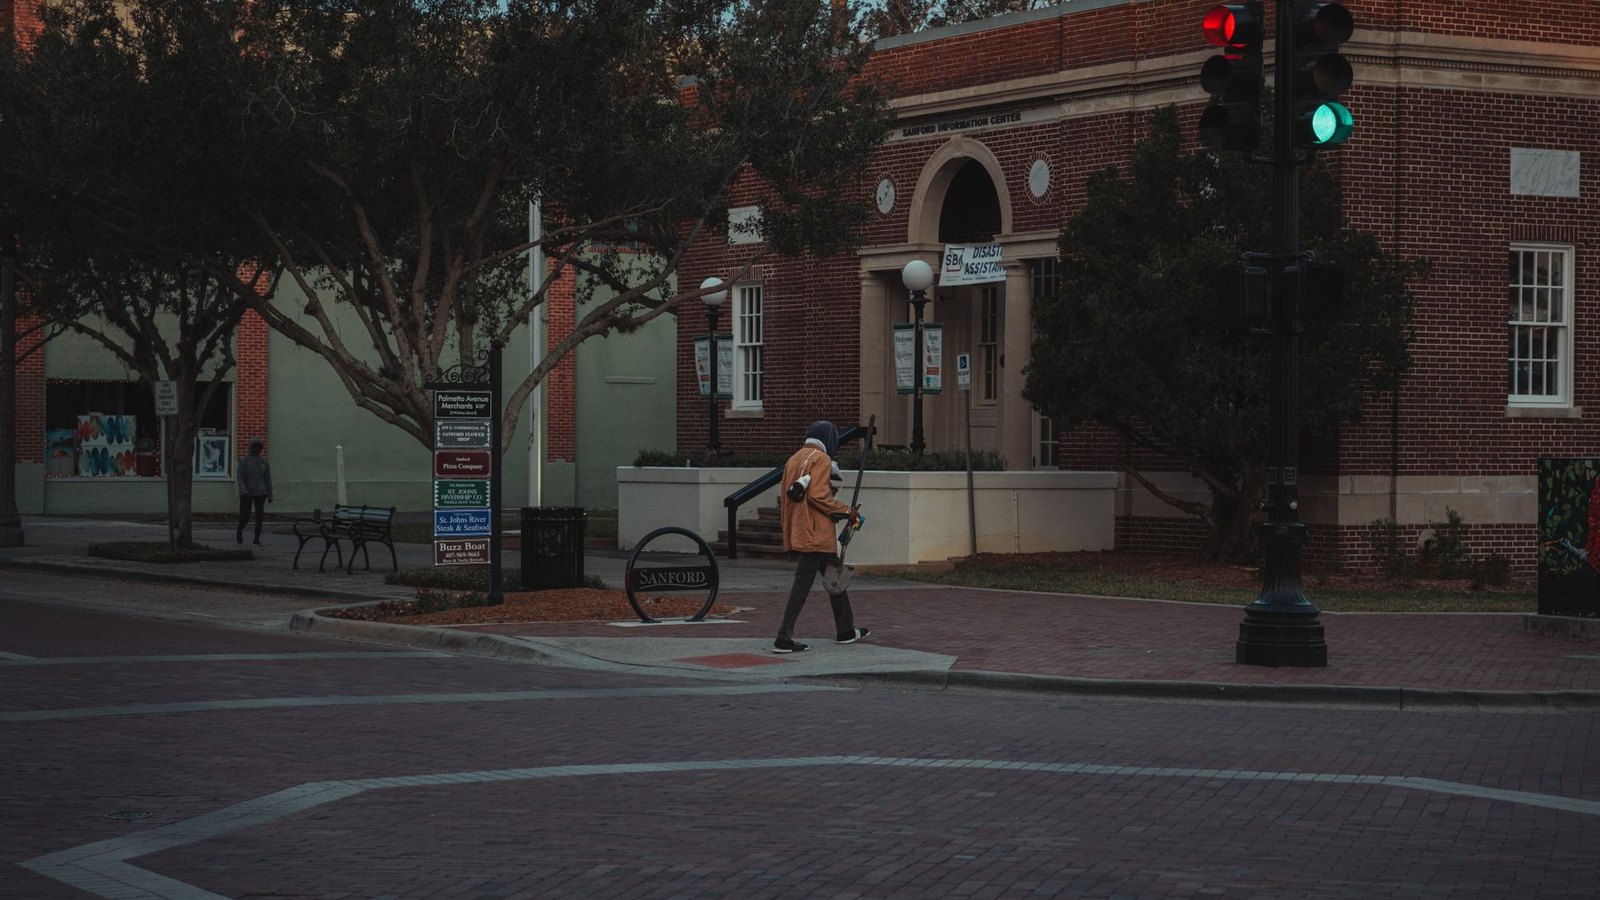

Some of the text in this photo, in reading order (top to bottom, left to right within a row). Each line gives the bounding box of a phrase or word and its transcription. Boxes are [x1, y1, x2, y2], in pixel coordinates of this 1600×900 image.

[902, 113, 1021, 137] SANFORD INFORMATION CENTER
[973, 246, 1002, 258] DISAST
[439, 516, 448, 524] St.
[440, 542, 485, 551] Buzz Boat
[640, 569, 705, 584] SANFORD
